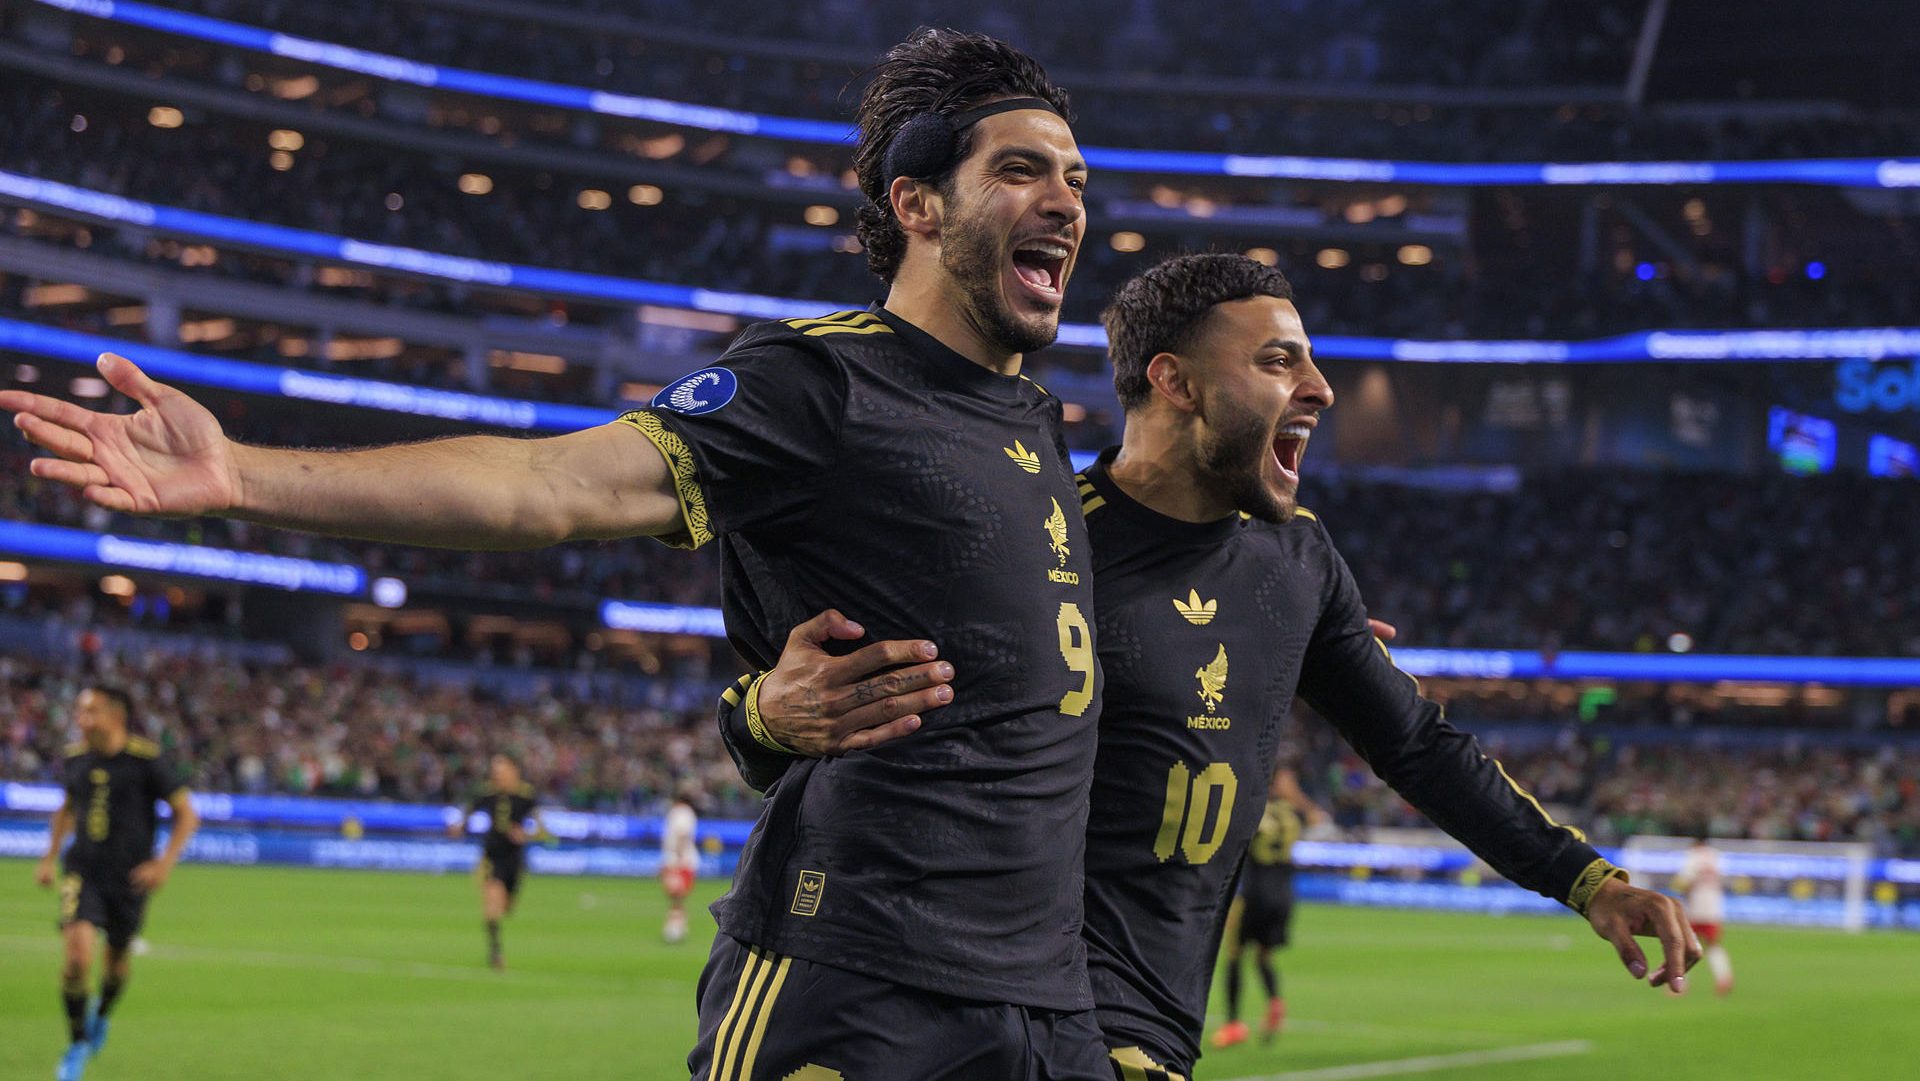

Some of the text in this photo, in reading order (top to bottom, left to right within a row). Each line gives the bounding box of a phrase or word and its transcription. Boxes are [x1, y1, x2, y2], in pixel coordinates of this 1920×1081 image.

[1836, 357, 1920, 413] So
[1047, 567, 1080, 586] MÉXICO
[1056, 602, 1094, 717] 9
[1187, 714, 1231, 730] MÉXICO
[1153, 760, 1238, 864] 10
